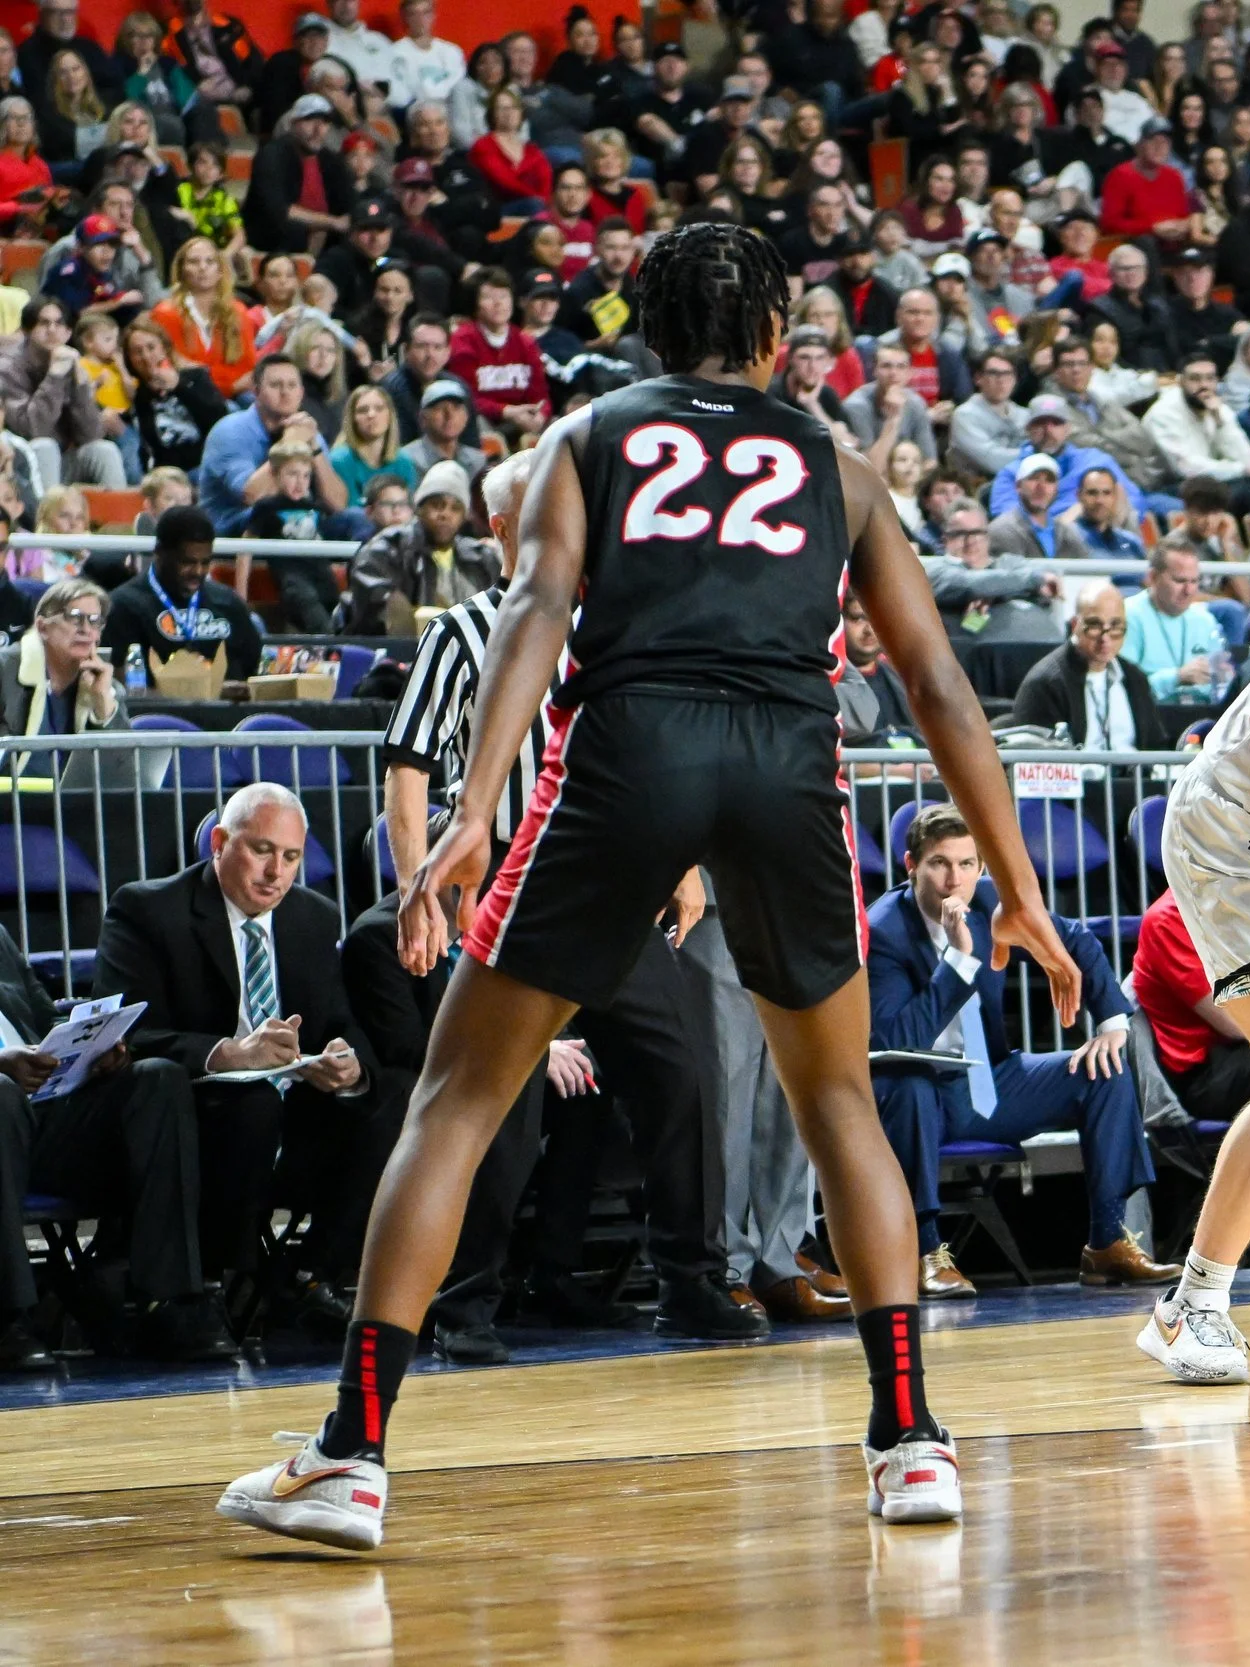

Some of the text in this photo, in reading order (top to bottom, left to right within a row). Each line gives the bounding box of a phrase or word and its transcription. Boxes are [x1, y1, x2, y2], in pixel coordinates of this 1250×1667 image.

[691, 398, 735, 413] AMDG
[622, 421, 811, 556] 22
[1018, 764, 1078, 781] NATIONAL
